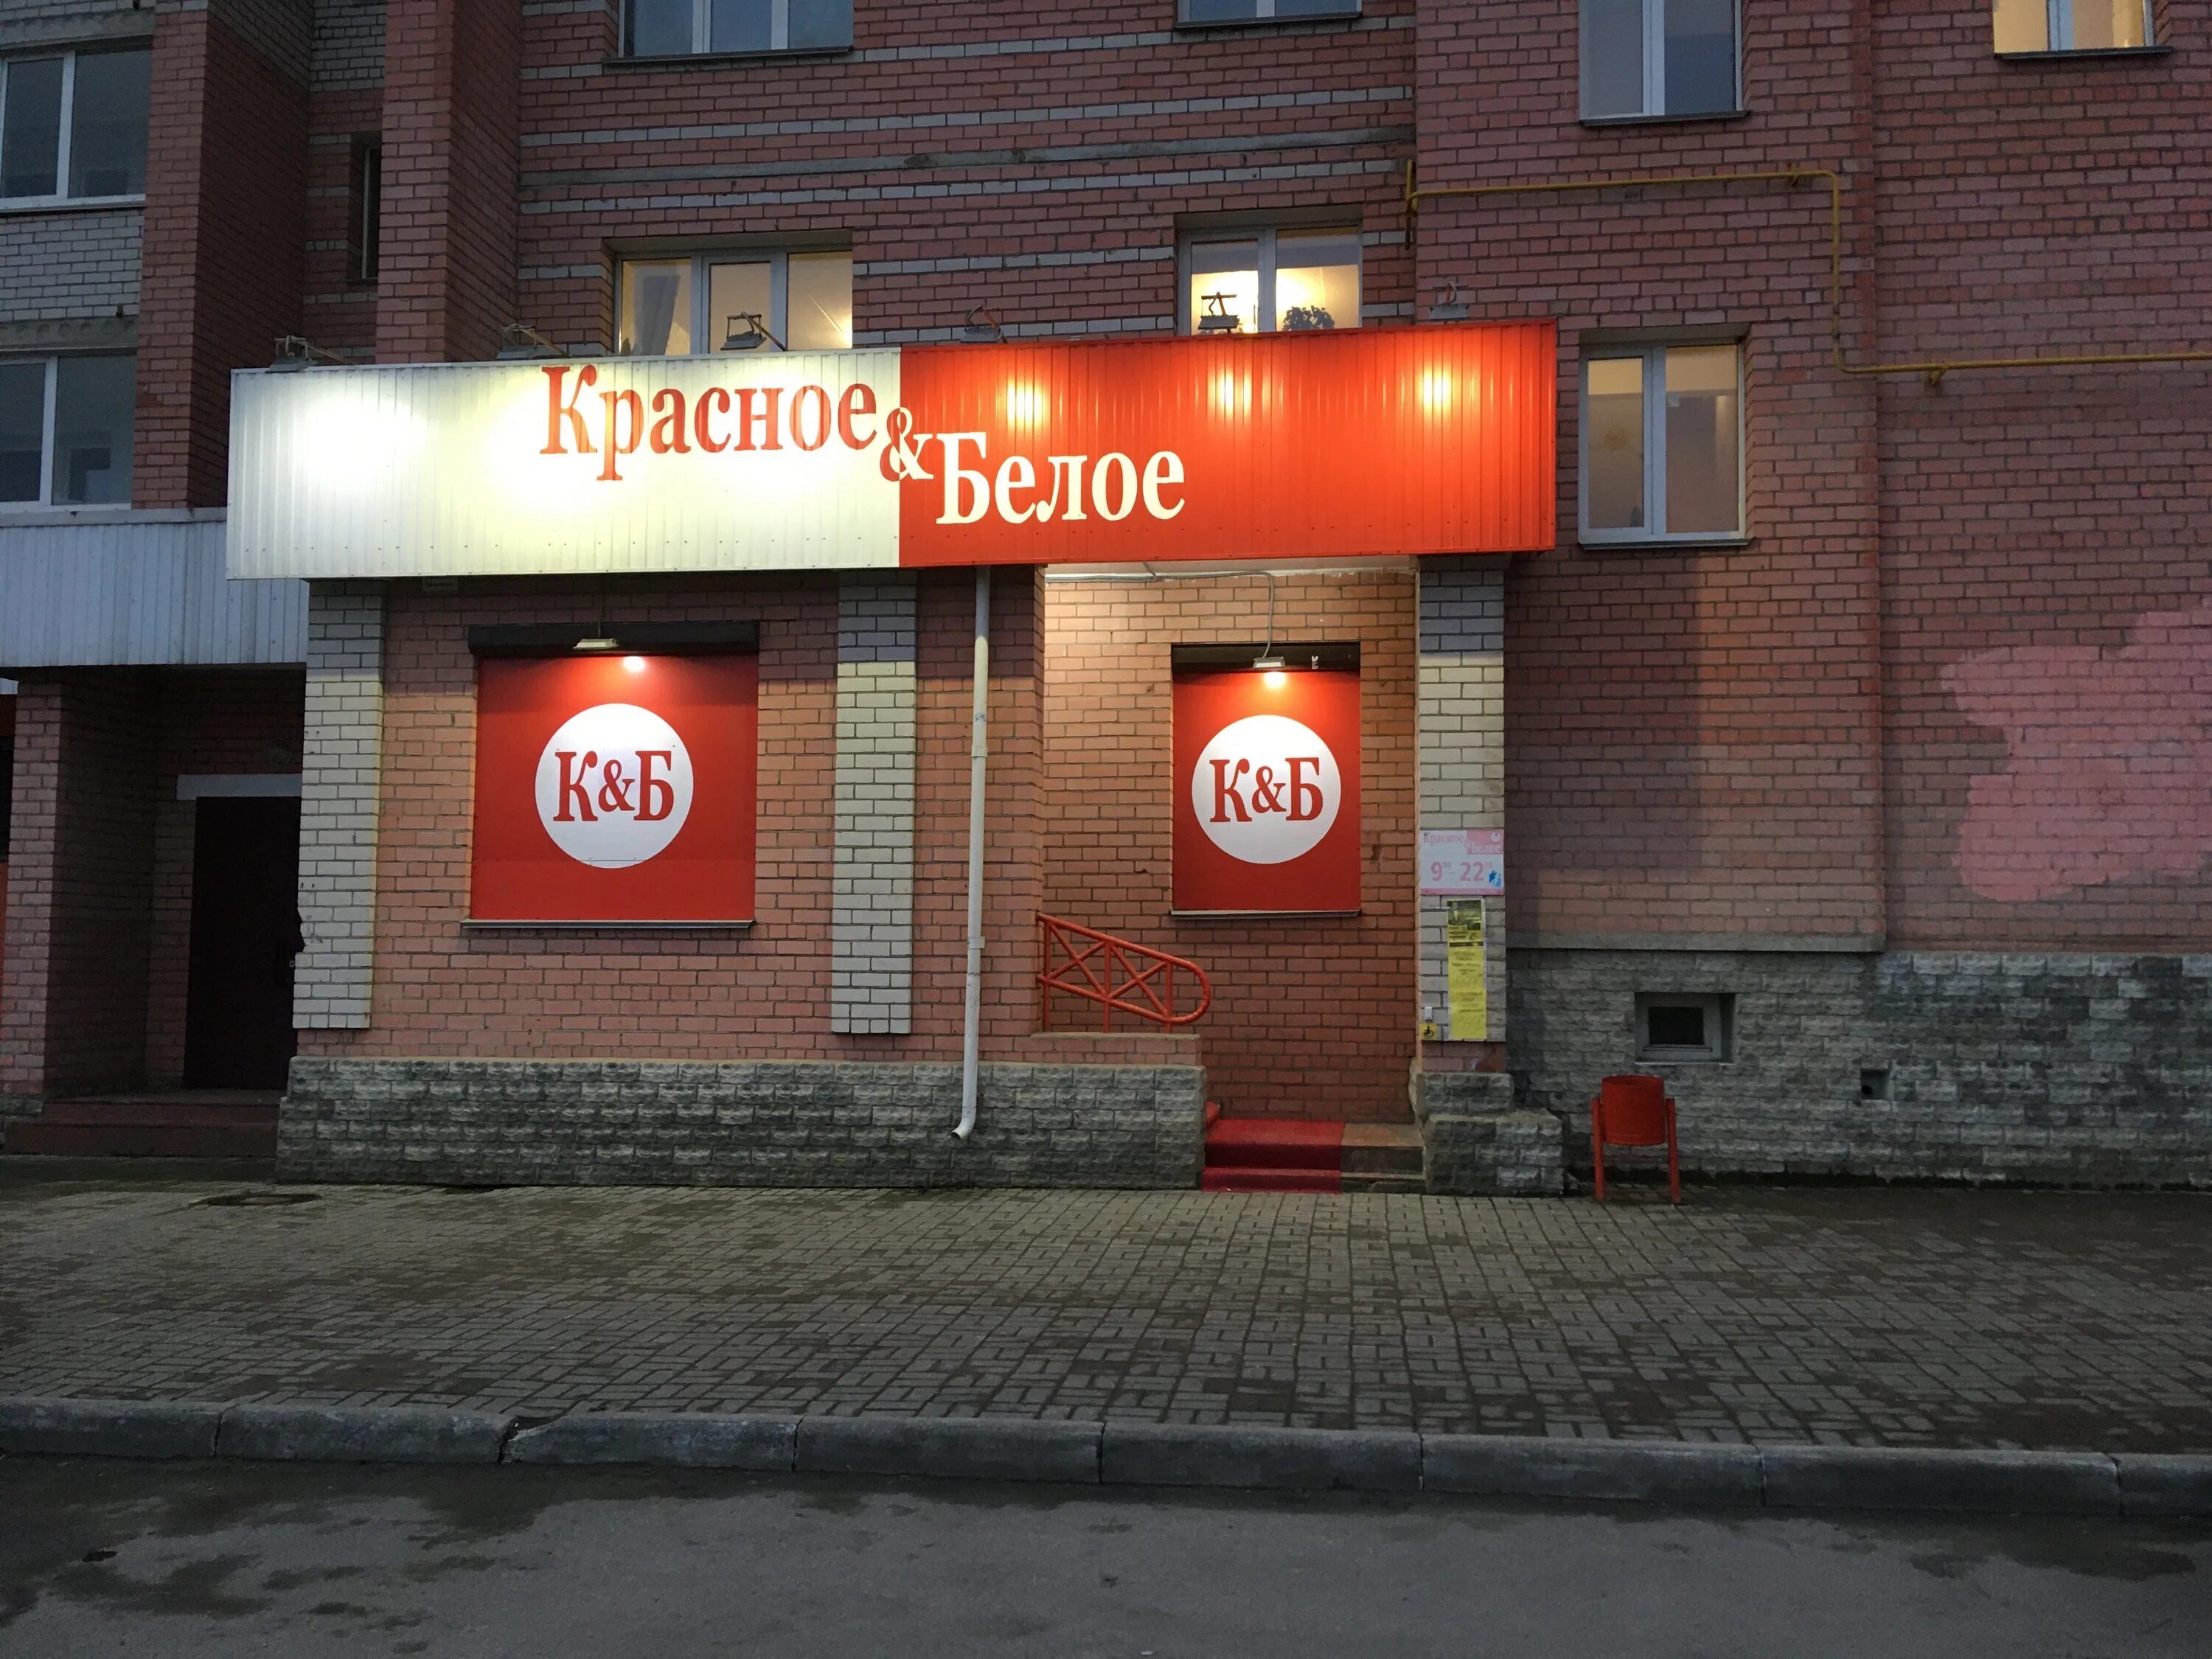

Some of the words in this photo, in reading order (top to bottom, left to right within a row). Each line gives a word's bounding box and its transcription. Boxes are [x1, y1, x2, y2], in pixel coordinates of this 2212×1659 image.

[540, 364, 877, 481] Красное
[880, 407, 934, 481] &
[936, 431, 1185, 524] Белое
[553, 751, 674, 821] К&Б
[1209, 757, 1323, 822] К&Б
